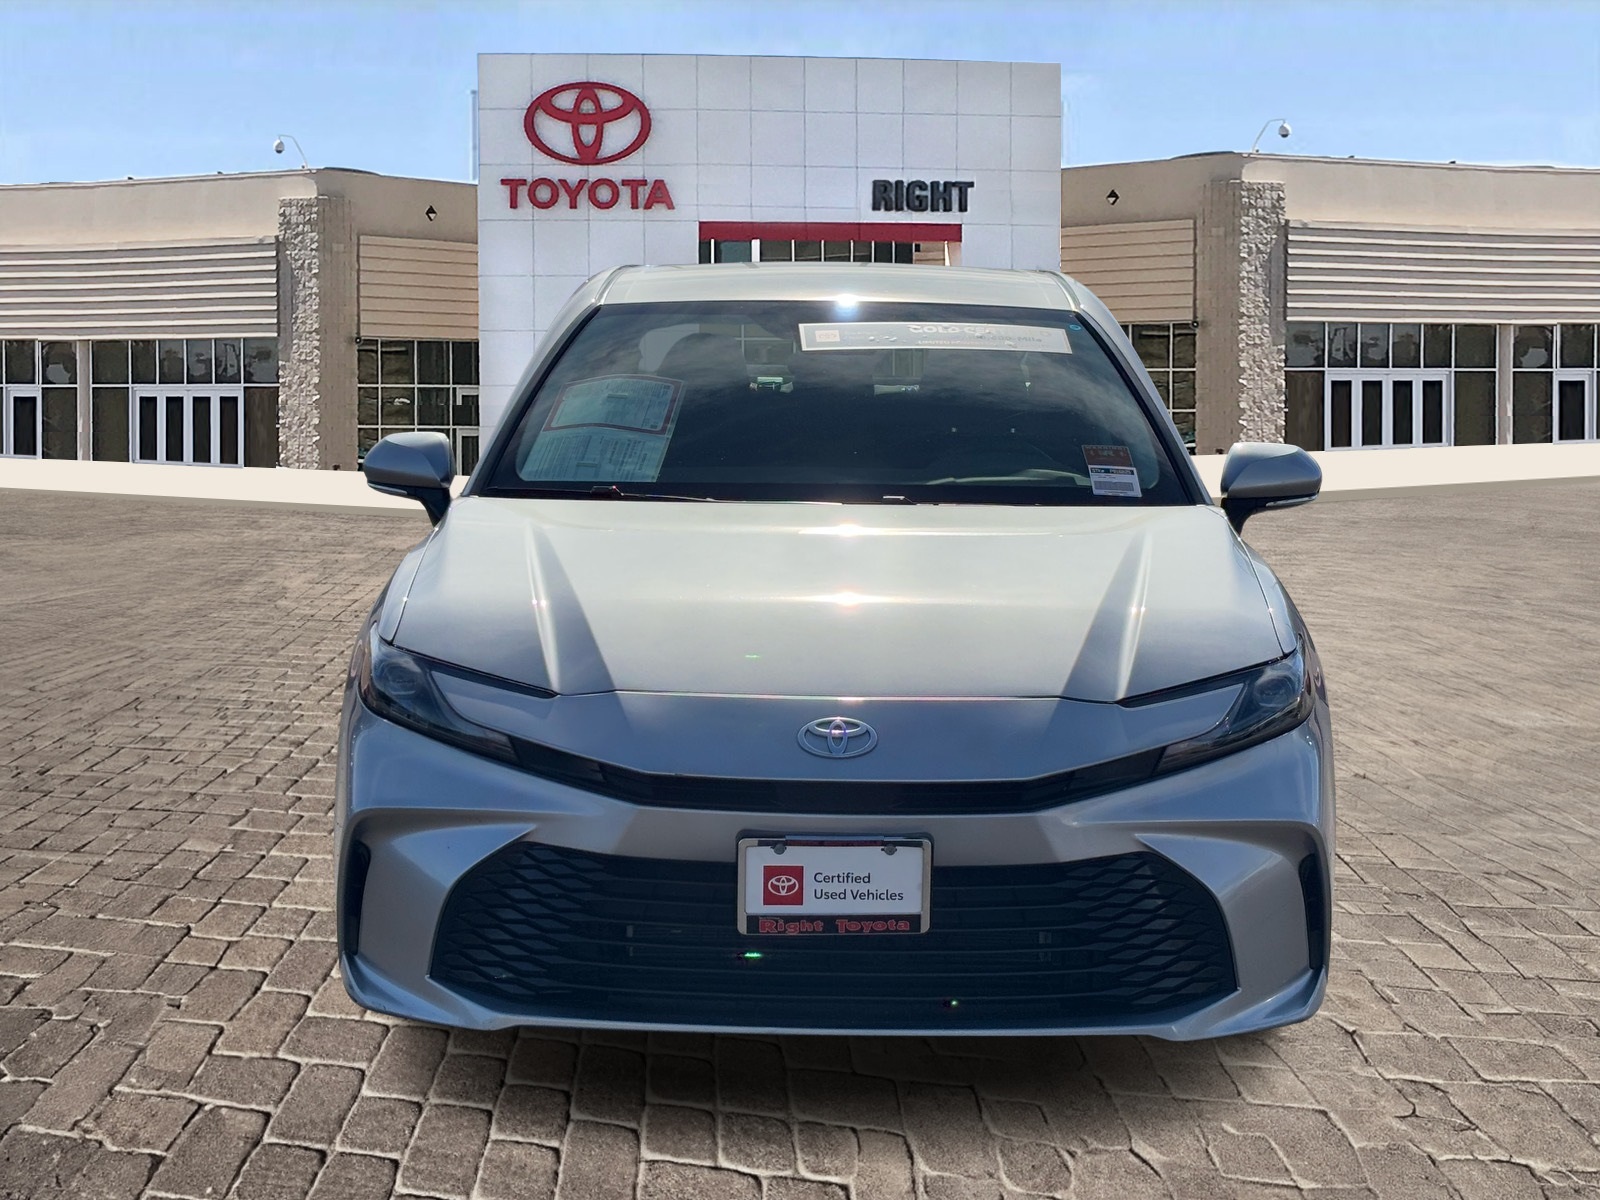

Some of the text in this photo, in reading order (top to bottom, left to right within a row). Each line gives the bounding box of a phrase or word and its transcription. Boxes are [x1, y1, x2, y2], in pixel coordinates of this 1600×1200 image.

[500, 177, 675, 210] TOYOTA
[872, 179, 975, 212] RIGHT
[813, 872, 871, 884] Certified
[814, 888, 904, 901] Used Vehicles
[758, 918, 910, 934] Right Toyota
